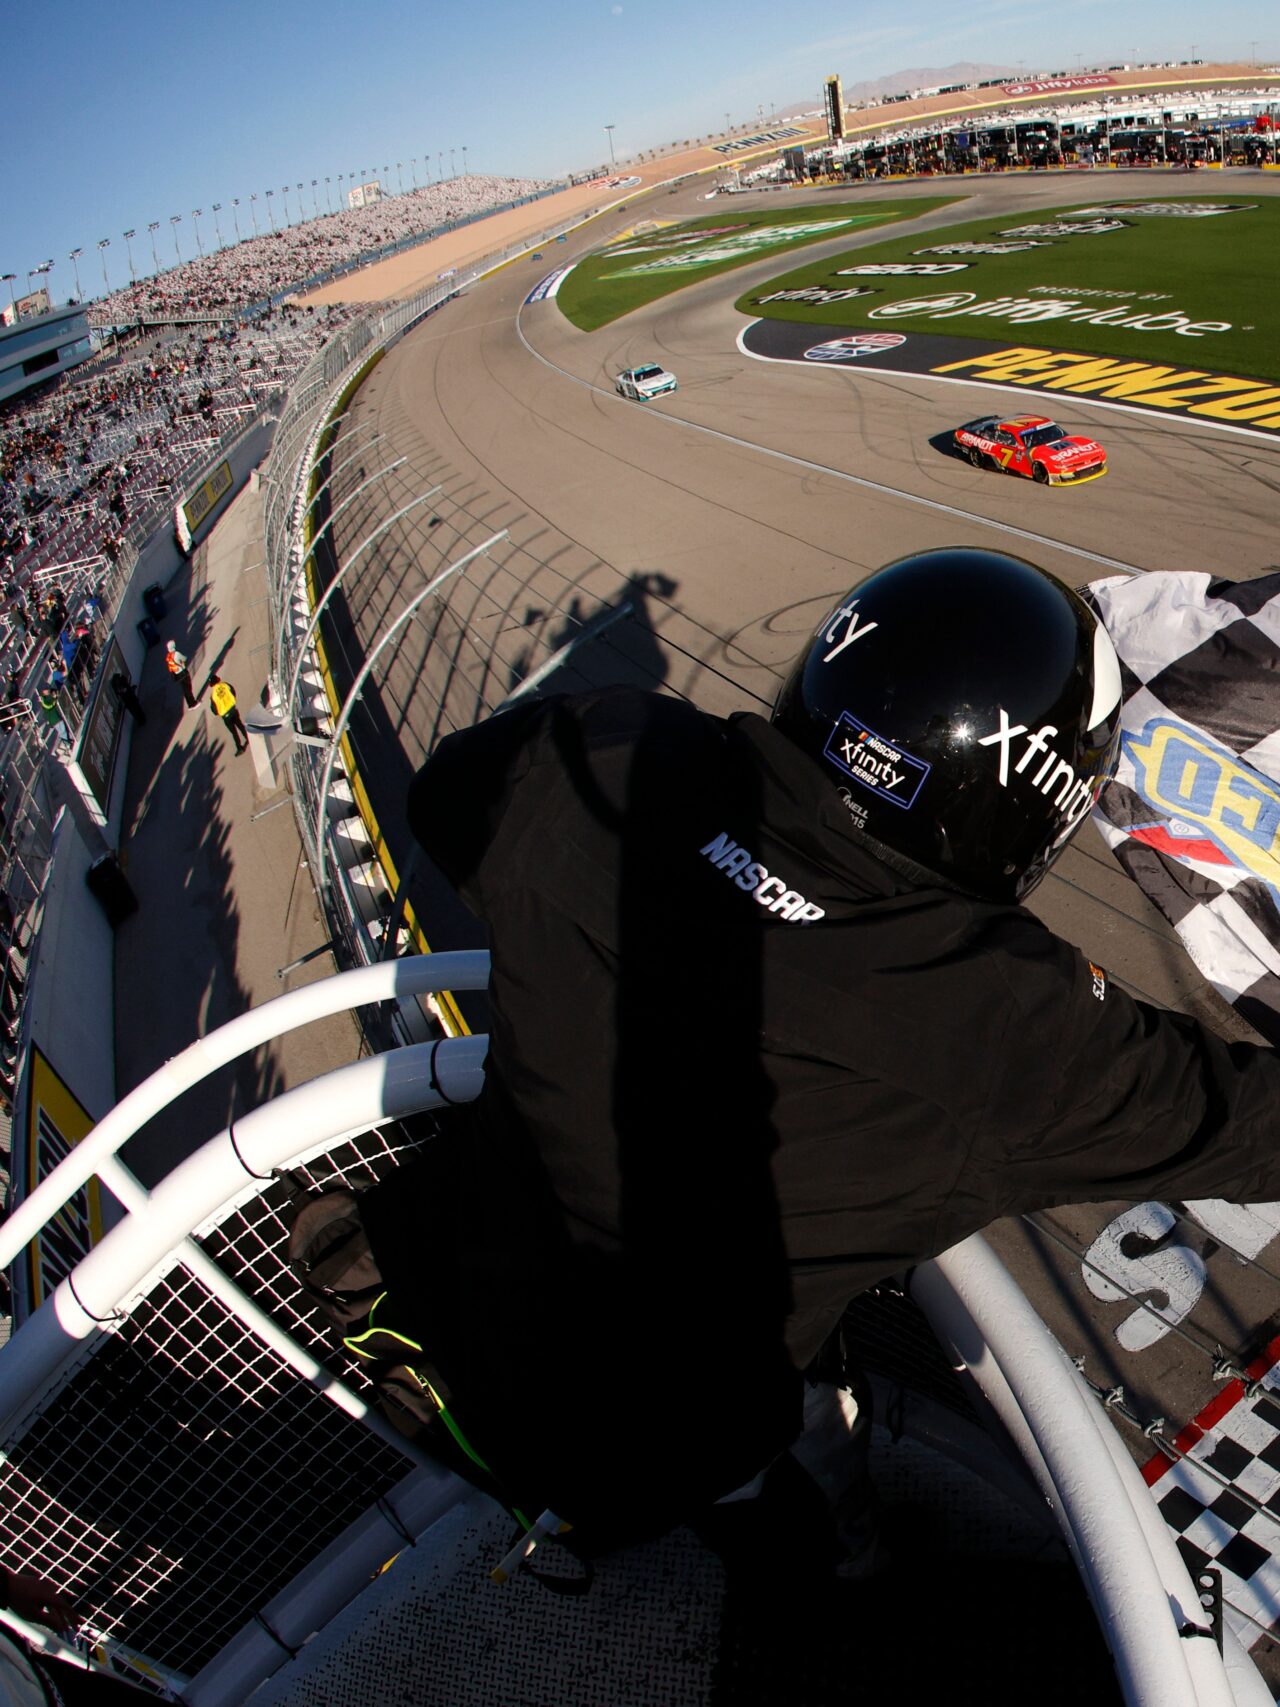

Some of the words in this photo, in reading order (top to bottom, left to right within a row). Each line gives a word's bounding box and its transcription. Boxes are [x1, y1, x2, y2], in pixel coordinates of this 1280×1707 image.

[712, 126, 810, 154] PENNZOIL
[961, 432, 997, 452] BRANDT
[1050, 442, 1099, 463] BRANDT
[1000, 447, 1014, 468] 7
[866, 737, 902, 763] NASCAR
[851, 764, 879, 786] SERIES
